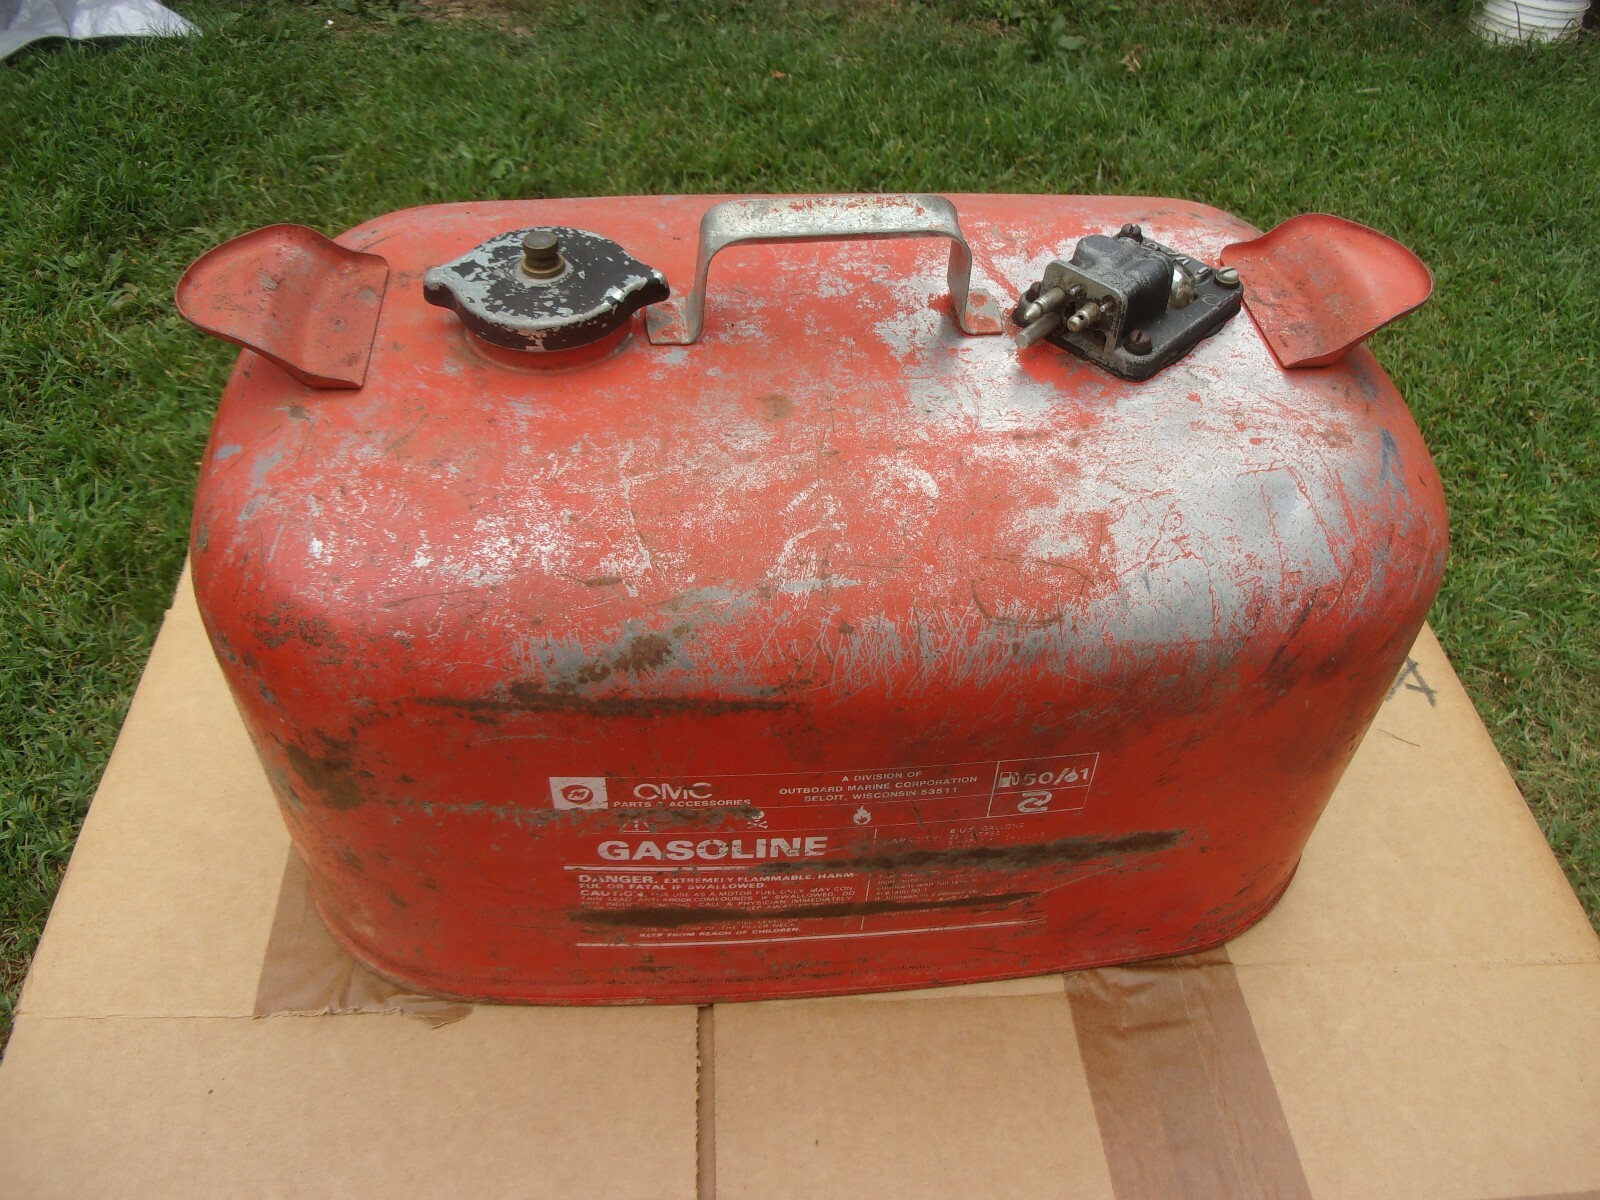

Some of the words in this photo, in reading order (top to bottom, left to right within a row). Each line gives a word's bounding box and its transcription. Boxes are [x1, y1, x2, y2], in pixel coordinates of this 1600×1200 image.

[854, 772, 903, 782] DIVISION
[907, 770, 923, 779] OF
[634, 782, 713, 800] OMC
[779, 785, 844, 796] OUTBOARD
[848, 782, 891, 792] MARINE
[895, 776, 978, 788] CORPORATION
[852, 789, 917, 801] WISCONSIN
[920, 786, 958, 796] 53511
[613, 800, 653, 808] PARTS
[669, 799, 752, 808] ACCESSORIES
[597, 836, 829, 861] GASOLINE
[578, 875, 659, 884] DANGER.
